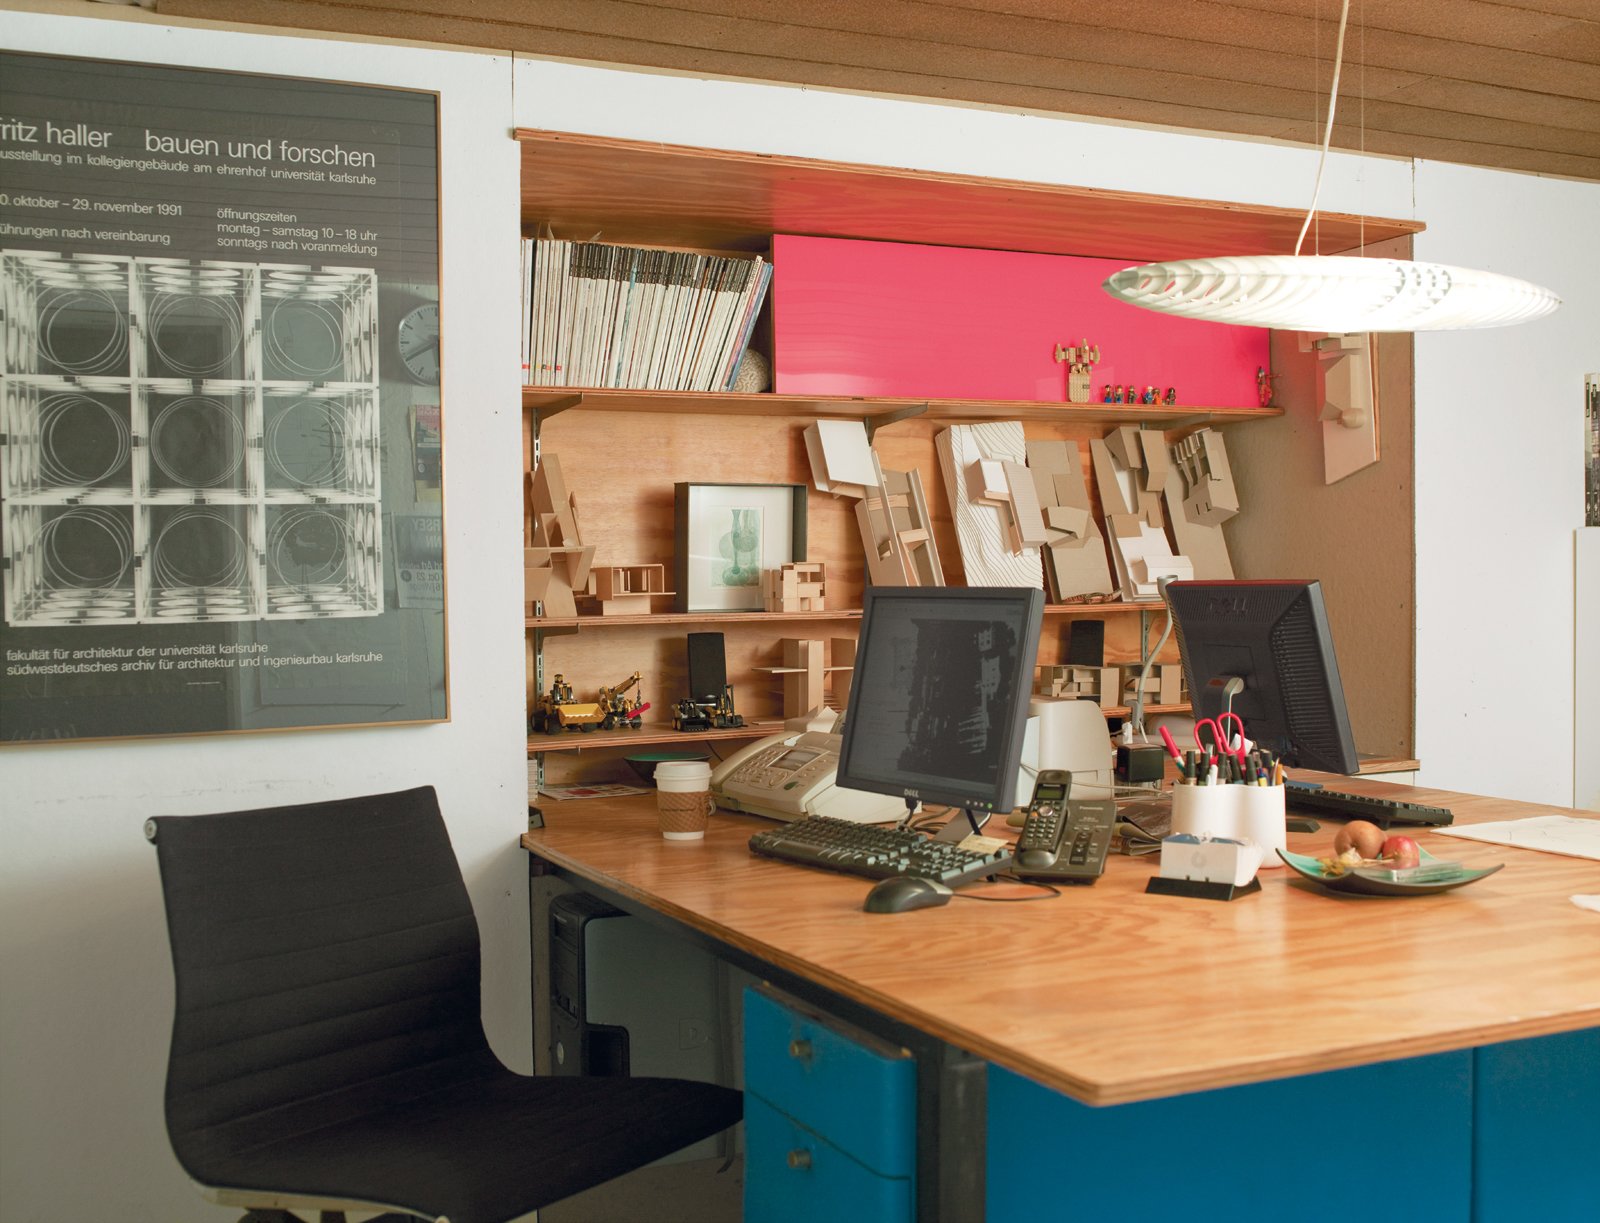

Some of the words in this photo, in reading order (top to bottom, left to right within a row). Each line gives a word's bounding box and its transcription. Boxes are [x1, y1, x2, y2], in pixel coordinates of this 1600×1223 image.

[46, 121, 112, 148] haller
[145, 129, 219, 156] bauen
[228, 139, 272, 160] und
[279, 140, 376, 168] forschen
[0, 150, 62, 165] usstellung
[66, 153, 82, 164] im
[87, 154, 189, 172] kollegiengebäude
[193, 164, 212, 174] am
[216, 164, 267, 177] ehrenhof
[270, 168, 325, 182] universität
[329, 172, 376, 185] karlsruhe
[13, 195, 60, 208] oktober
[72, 198, 92, 211] 29.
[93, 200, 153, 214] november
[156, 203, 183, 216] 1991
[216, 208, 297, 223] öffnungszeiten
[0, 223, 58, 239] ührungen
[61, 227, 91, 239] nach
[94, 229, 171, 246] vereinbarung
[217, 223, 260, 237] montag
[272, 226, 318, 240] samstag
[360, 230, 378, 241] uhr
[217, 236, 268, 250] sonntags
[271, 239, 298, 251] nach
[301, 241, 378, 257] voranmeldung
[6, 649, 50, 661] fakultät
[53, 648, 69, 660] für
[72, 646, 133, 659] architektur
[137, 646, 156, 658] der
[159, 644, 216, 656] universität
[219, 643, 268, 654] karlsruhe
[6, 662, 118, 676] südwestdeutsches
[121, 659, 156, 672] archiv
[158, 659, 174, 671] für
[177, 656, 235, 669] architektur
[239, 656, 260, 667] und
[263, 654, 332, 668] ingenieurbau
[336, 651, 383, 663] karlsruhe
[903, 787, 919, 798] DELL
